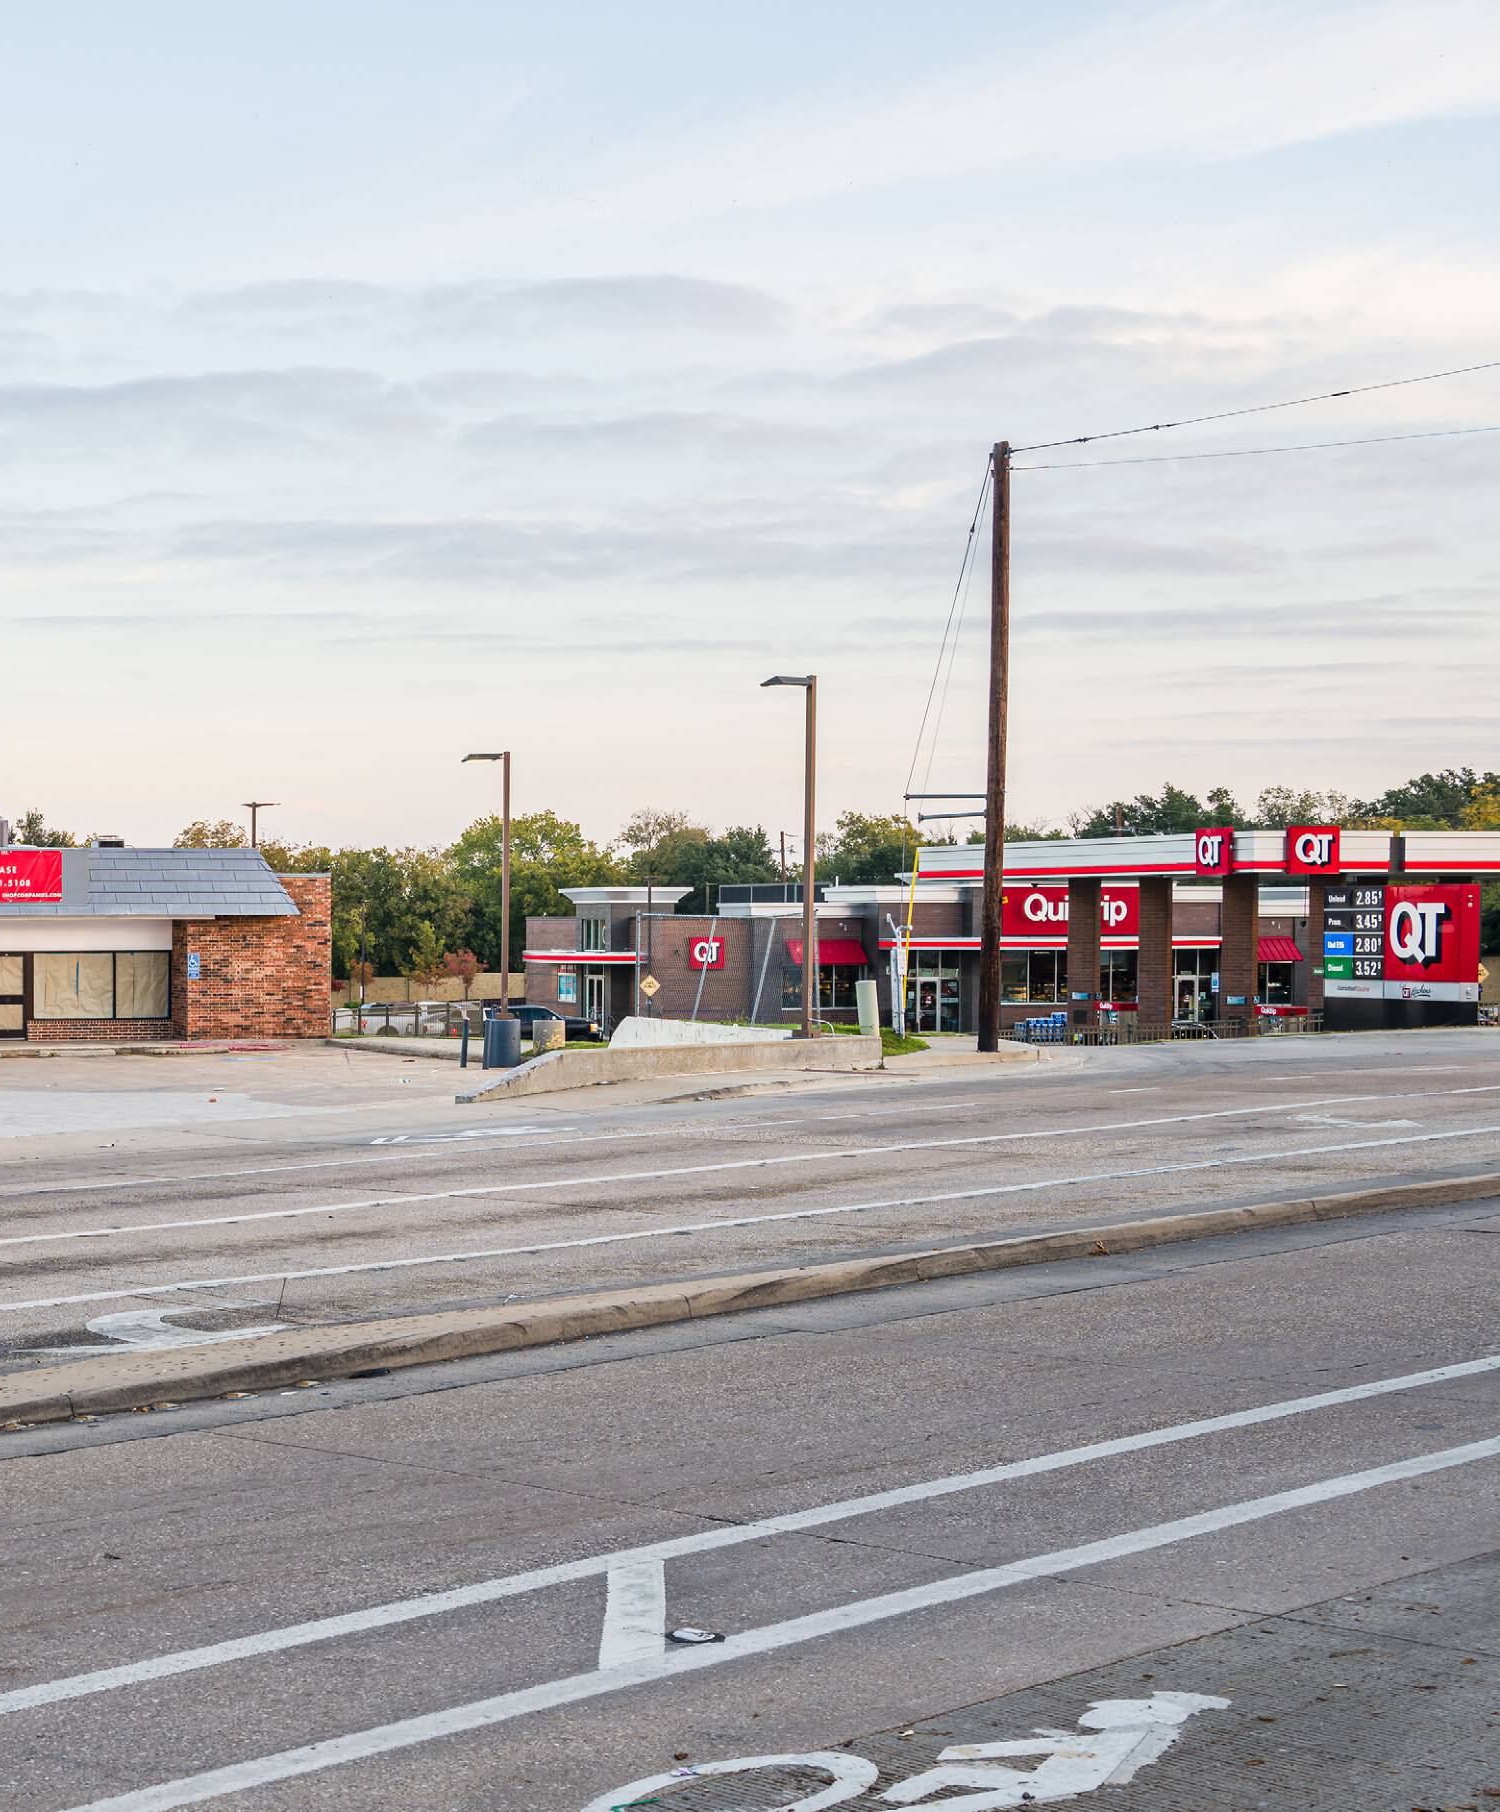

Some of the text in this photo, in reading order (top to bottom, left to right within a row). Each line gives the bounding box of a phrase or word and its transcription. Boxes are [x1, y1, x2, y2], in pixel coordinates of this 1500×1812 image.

[1198, 835, 1224, 867] QT
[1295, 833, 1335, 865] QT
[1024, 893, 1127, 927] Quiip
[1389, 901, 1445, 963] QT
